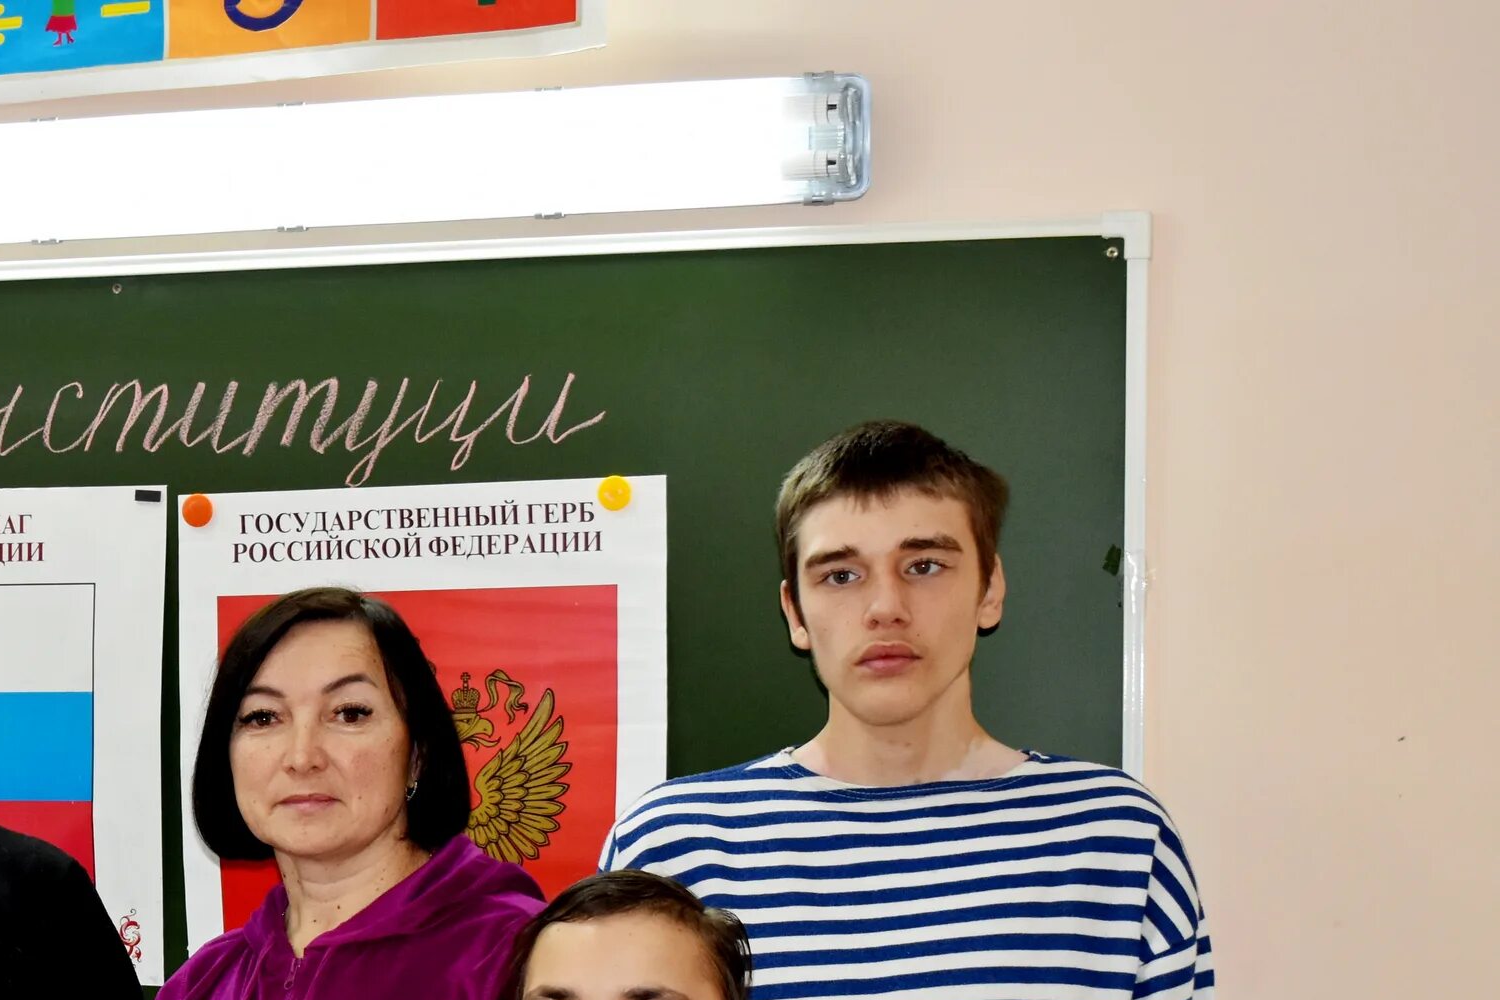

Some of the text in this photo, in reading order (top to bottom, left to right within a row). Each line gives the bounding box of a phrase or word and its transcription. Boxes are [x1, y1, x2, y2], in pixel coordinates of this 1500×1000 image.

[238, 499, 595, 537] ГОСУДАРСТВЕННЫЙ ГЕРБ
[232, 530, 603, 564] РОССИЙСКОЙ ФЕДЕРАЦИИ
